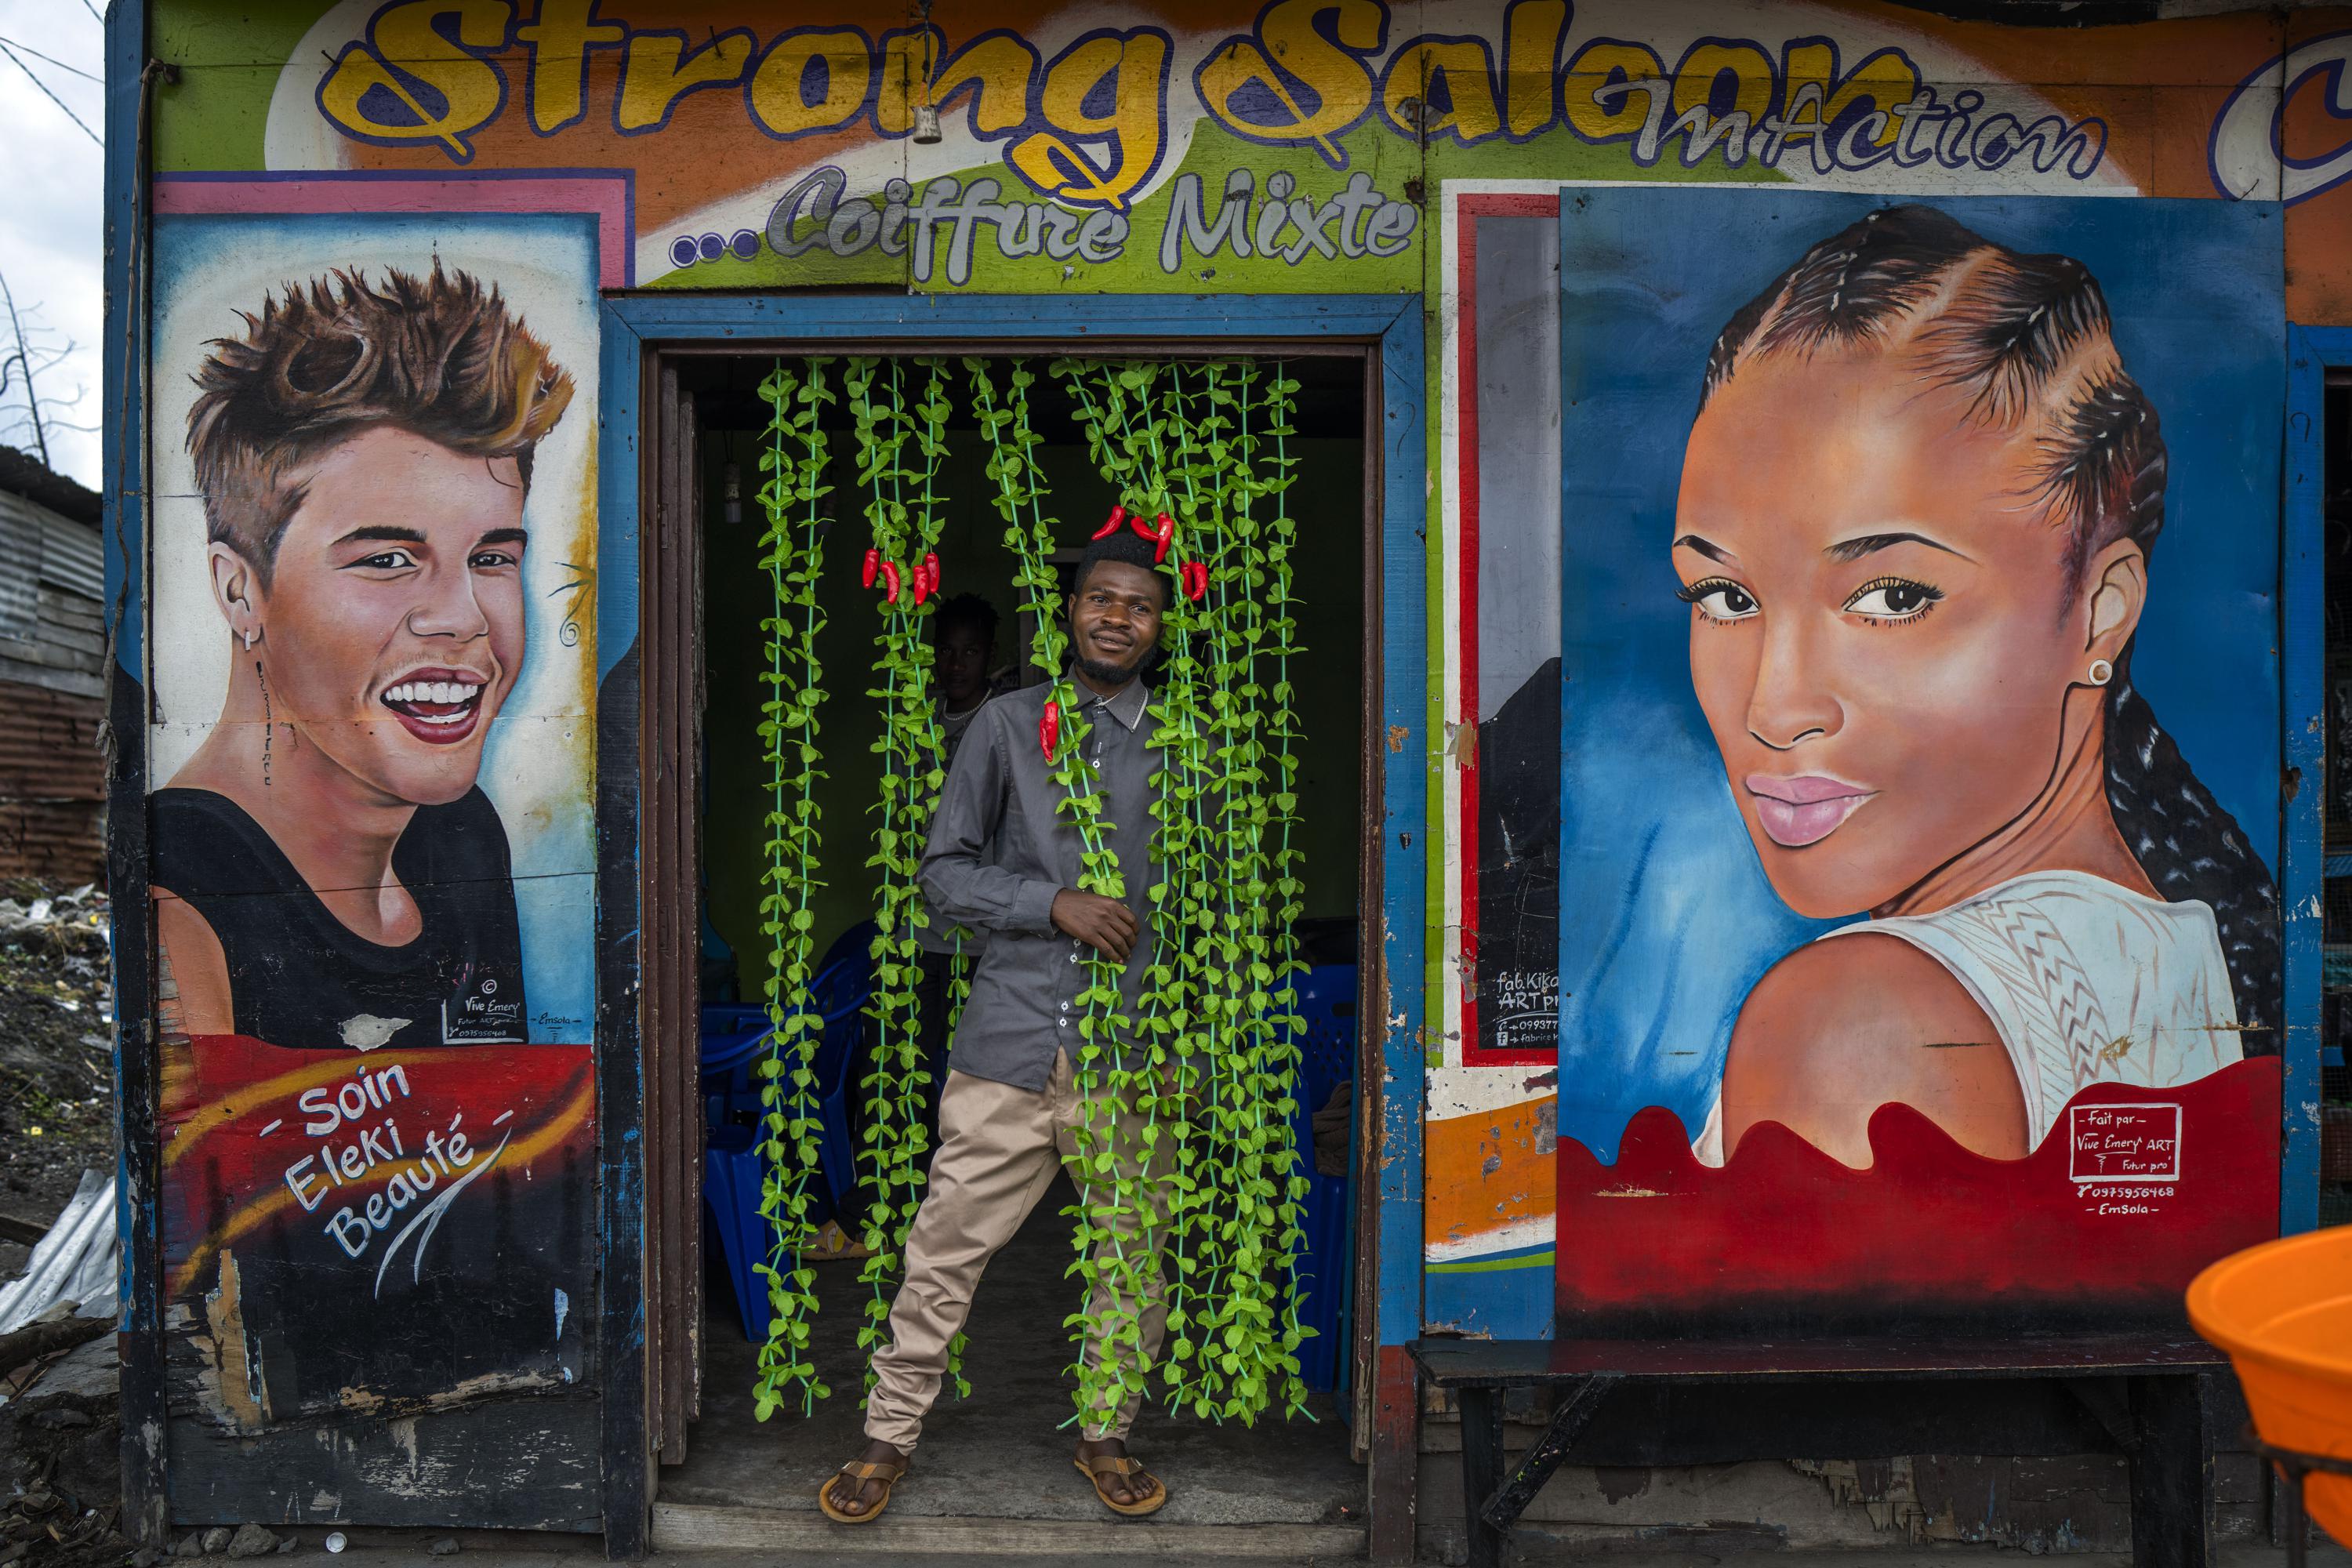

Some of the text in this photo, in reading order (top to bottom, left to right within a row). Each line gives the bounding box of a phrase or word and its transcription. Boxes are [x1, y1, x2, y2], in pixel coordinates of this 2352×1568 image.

[315, 0, 1922, 215] Strong Saloon
[1158, 167, 1416, 274] Mixte
[465, 996, 485, 1011] Vive
[1498, 992, 1541, 1010] ART
[1521, 1033, 1552, 1044] fabrice
[299, 1065, 411, 1136] Soin
[2088, 1110, 2136, 1128] Fait par
[2146, 1139, 2175, 1151] ART
[285, 1117, 403, 1213] Eleki
[2122, 1160, 2147, 1171] Futur
[324, 1112, 475, 1259] Beauté
[2092, 1187, 2174, 1199] 0975956468
